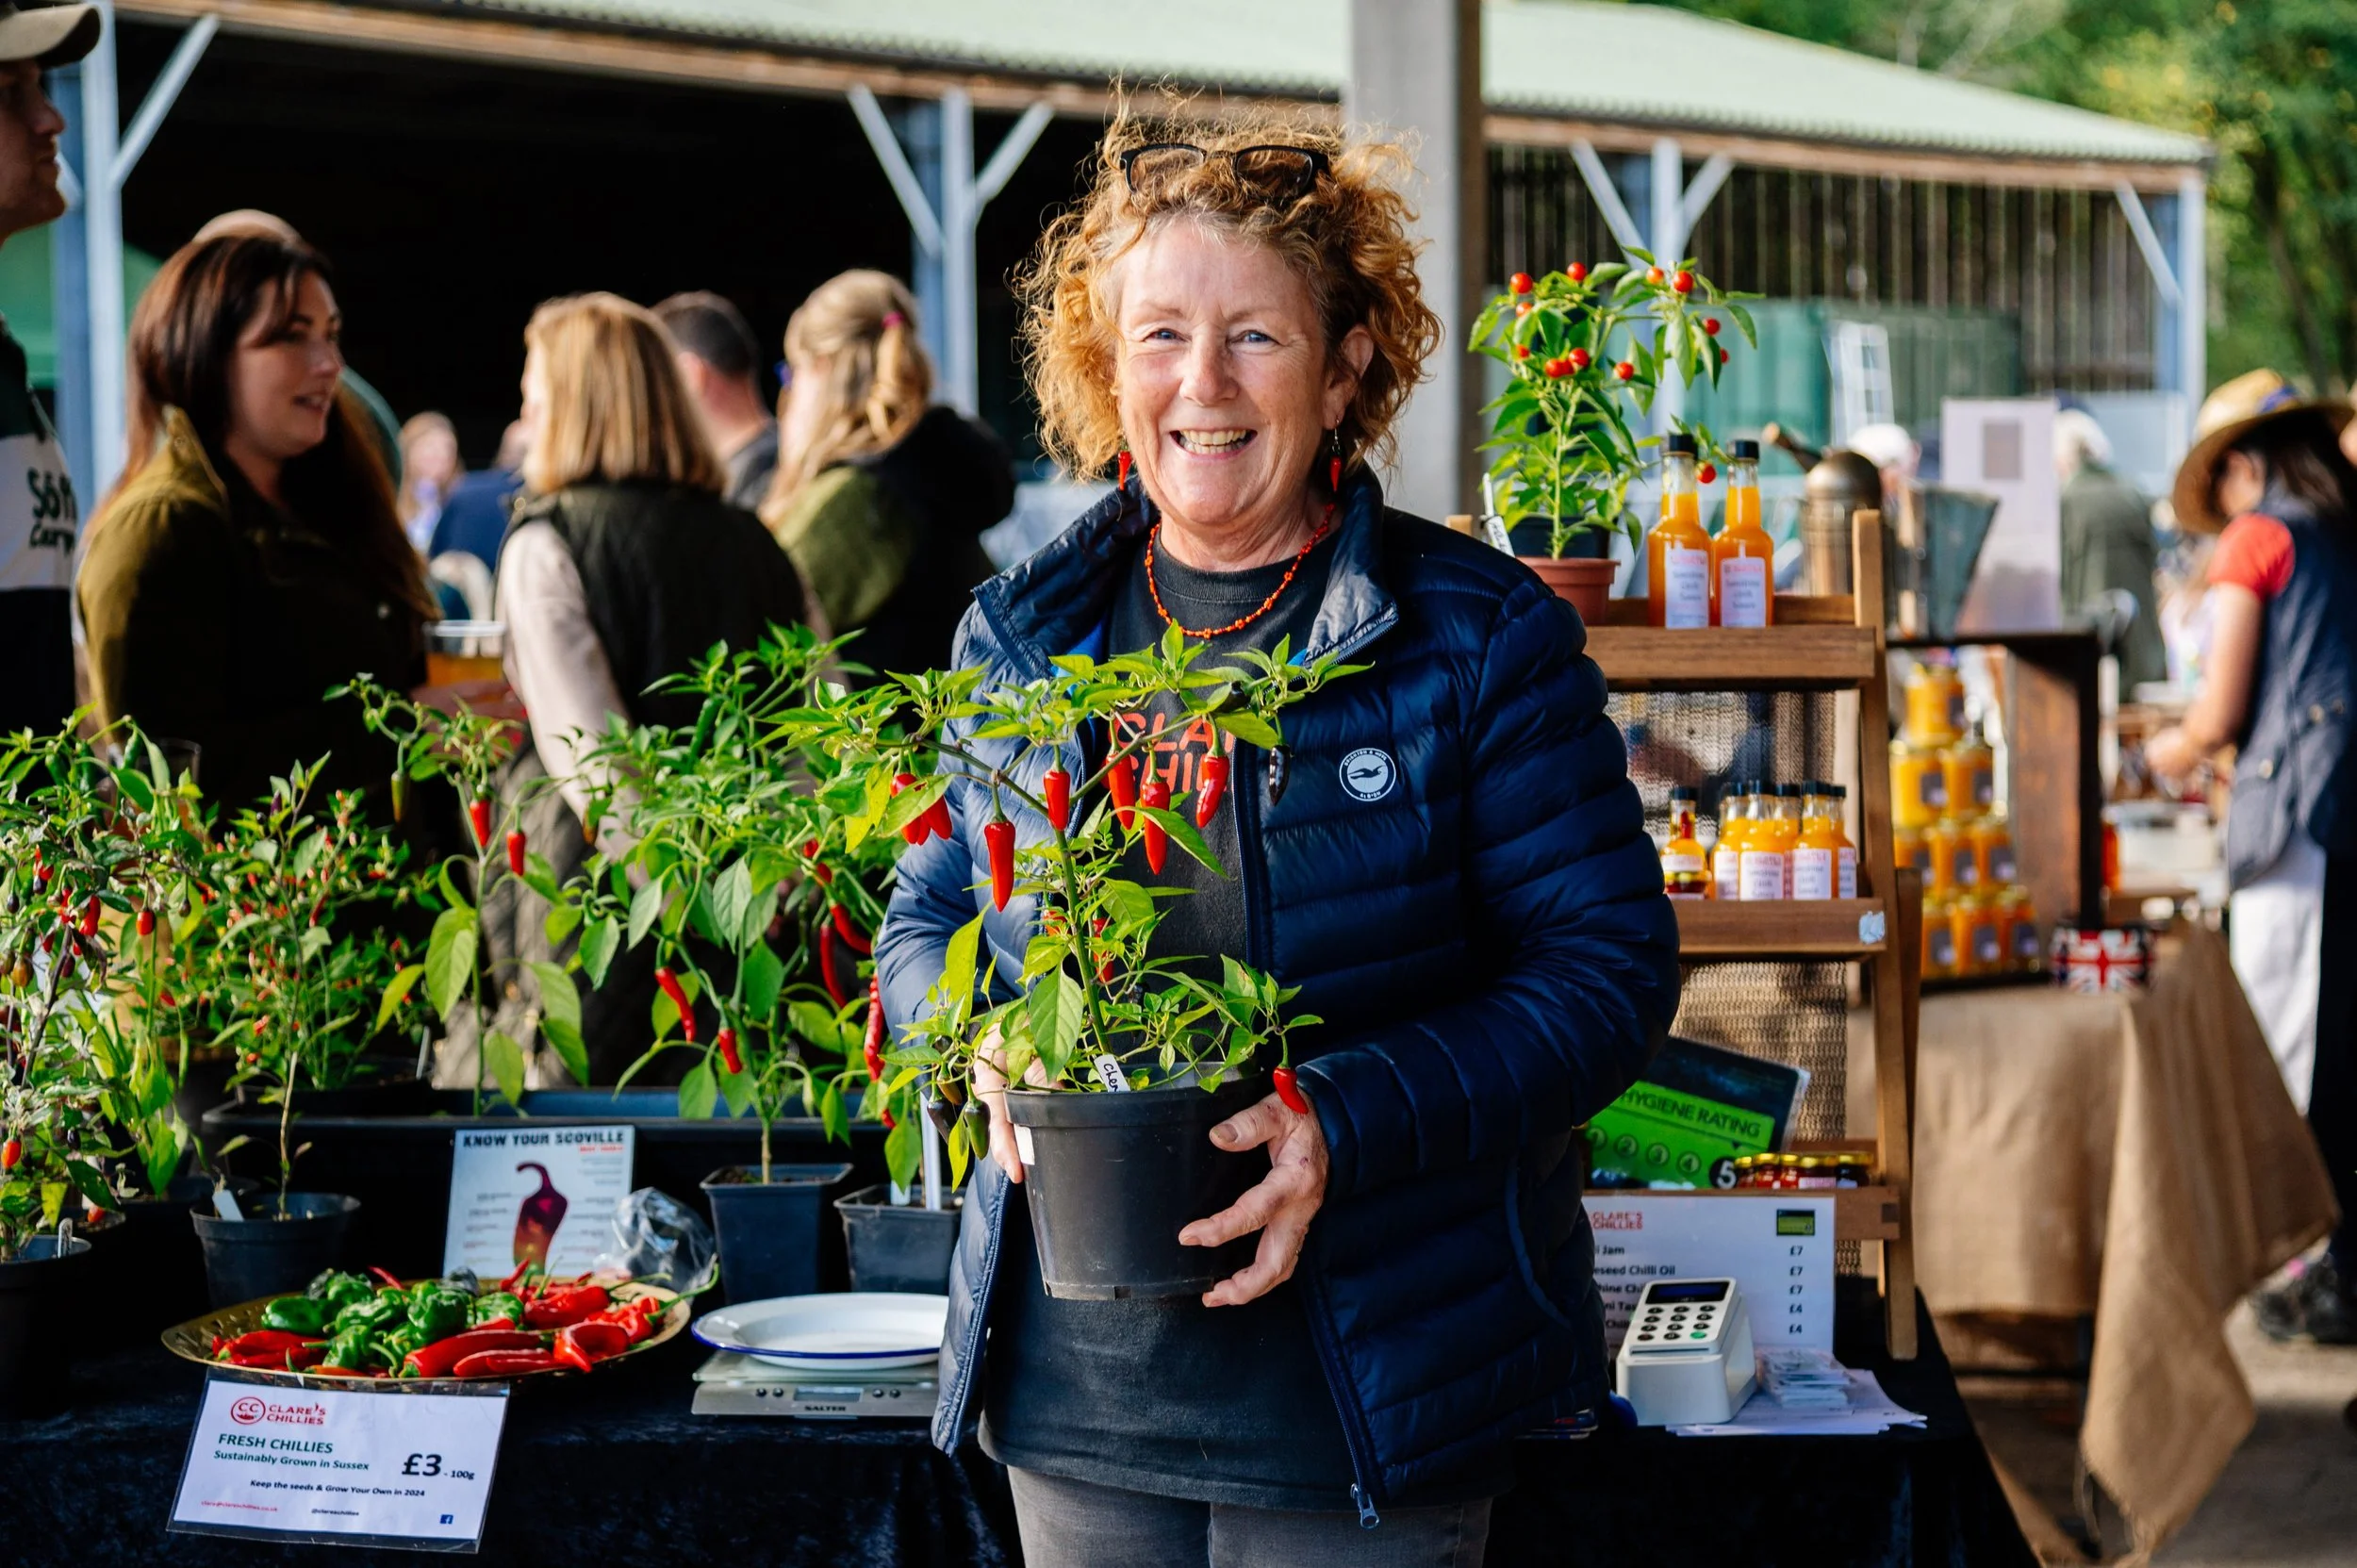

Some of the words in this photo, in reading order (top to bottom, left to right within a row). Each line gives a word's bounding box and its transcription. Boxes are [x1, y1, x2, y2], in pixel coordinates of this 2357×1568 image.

[1697, 1106, 1761, 1138] RATING
[463, 1134, 506, 1147] KNOW
[513, 1133, 549, 1146] YOUR
[554, 1131, 623, 1145] SCOVILLE
[1717, 1160, 1737, 1190] 5
[1603, 1245, 1624, 1256] Jam
[1789, 1245, 1803, 1256] £7
[1593, 1265, 1625, 1276] eseed
[1629, 1264, 1656, 1276] Chilli
[1659, 1265, 1675, 1276] Oil
[1789, 1265, 1803, 1277] £7
[1789, 1284, 1803, 1295] £7
[1788, 1303, 1803, 1314] £4
[1788, 1324, 1803, 1335] £4
[238, 1402, 260, 1413] CC
[269, 1402, 326, 1415] CLARE'S
[267, 1413, 324, 1426] CHILLIES
[218, 1432, 266, 1449] FRESH
[270, 1438, 334, 1454] CHILLIES
[213, 1449, 278, 1465] Sustainably
[280, 1456, 317, 1468] Grown
[320, 1458, 330, 1468] in
[333, 1460, 370, 1471] Sussex
[401, 1453, 442, 1477] £3
[451, 1470, 475, 1480] 100g
[250, 1479, 272, 1490] Keep
[273, 1481, 288, 1490] the
[351, 1486, 370, 1494] Your
